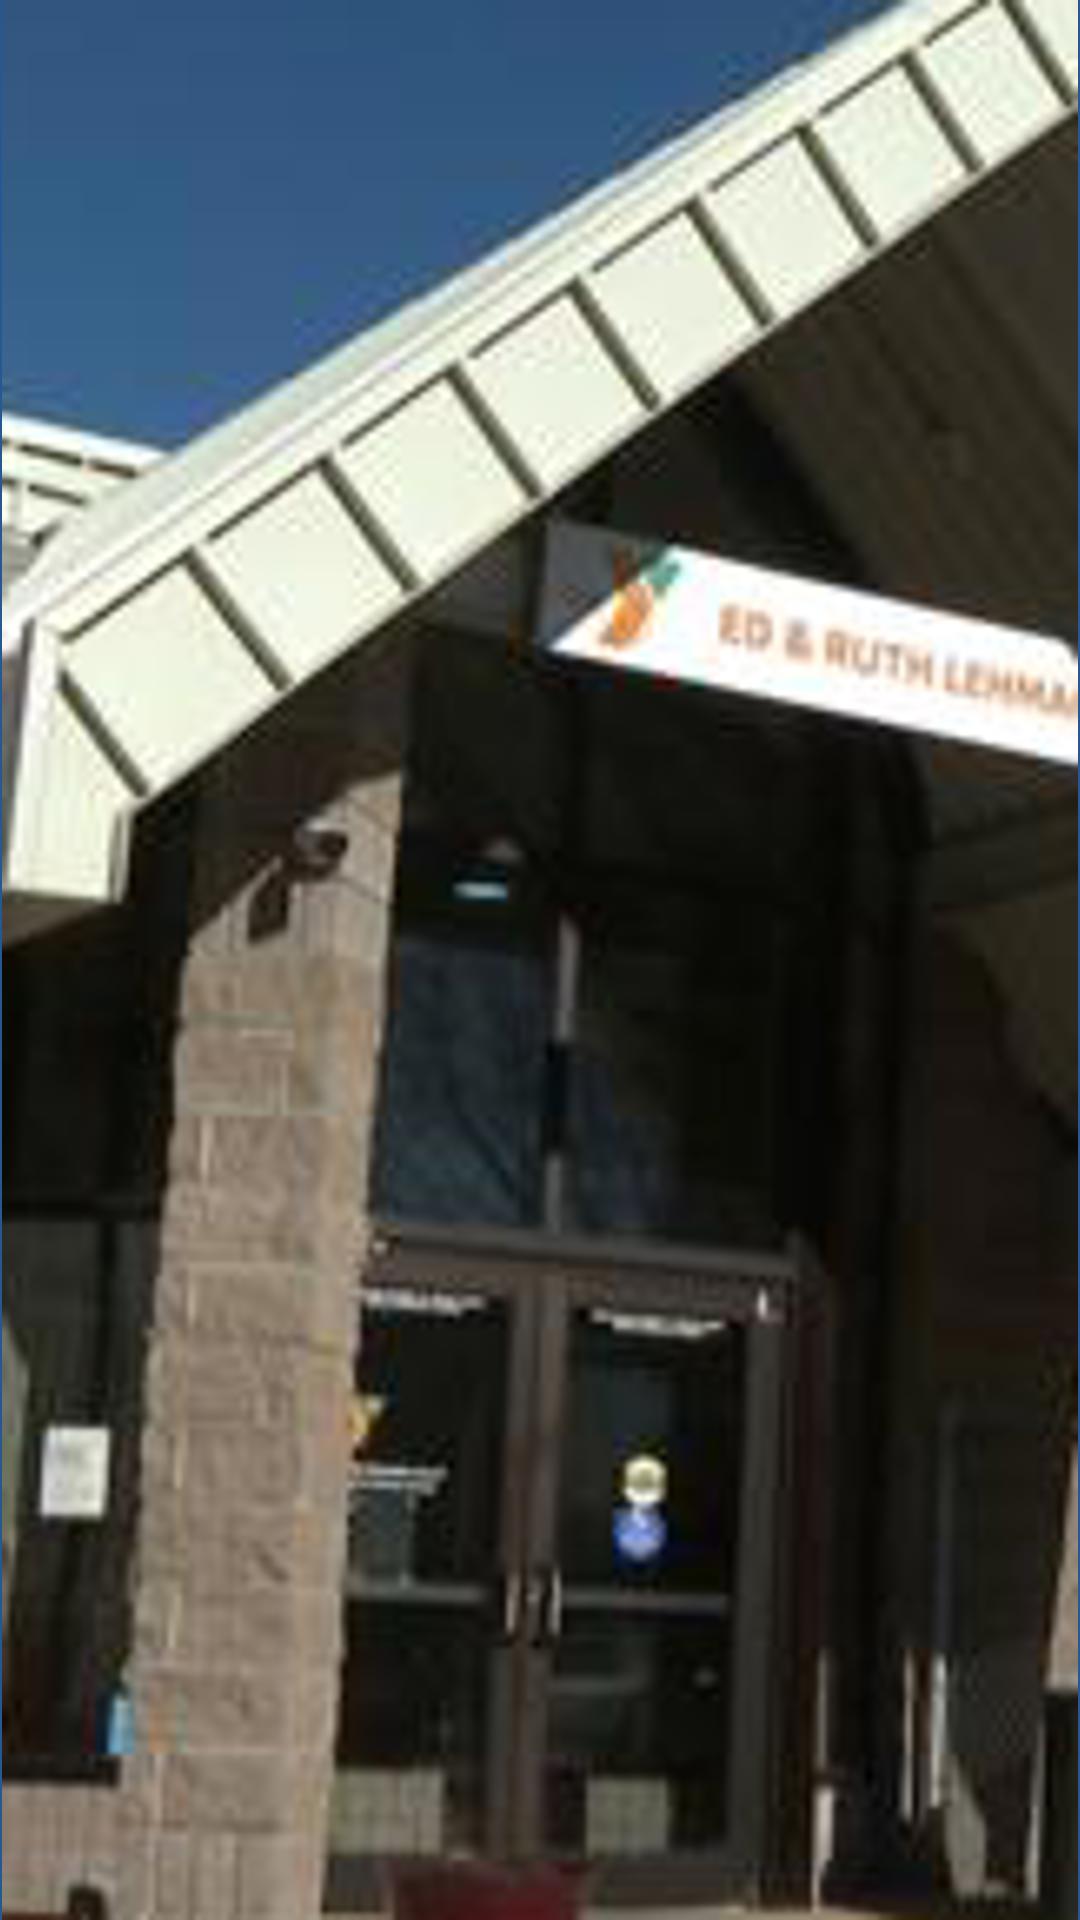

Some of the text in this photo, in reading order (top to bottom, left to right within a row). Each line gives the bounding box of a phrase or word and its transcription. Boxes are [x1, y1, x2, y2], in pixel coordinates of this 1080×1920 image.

[719, 604, 773, 650] ED
[785, 617, 813, 661] &
[825, 629, 933, 687] RUTH
